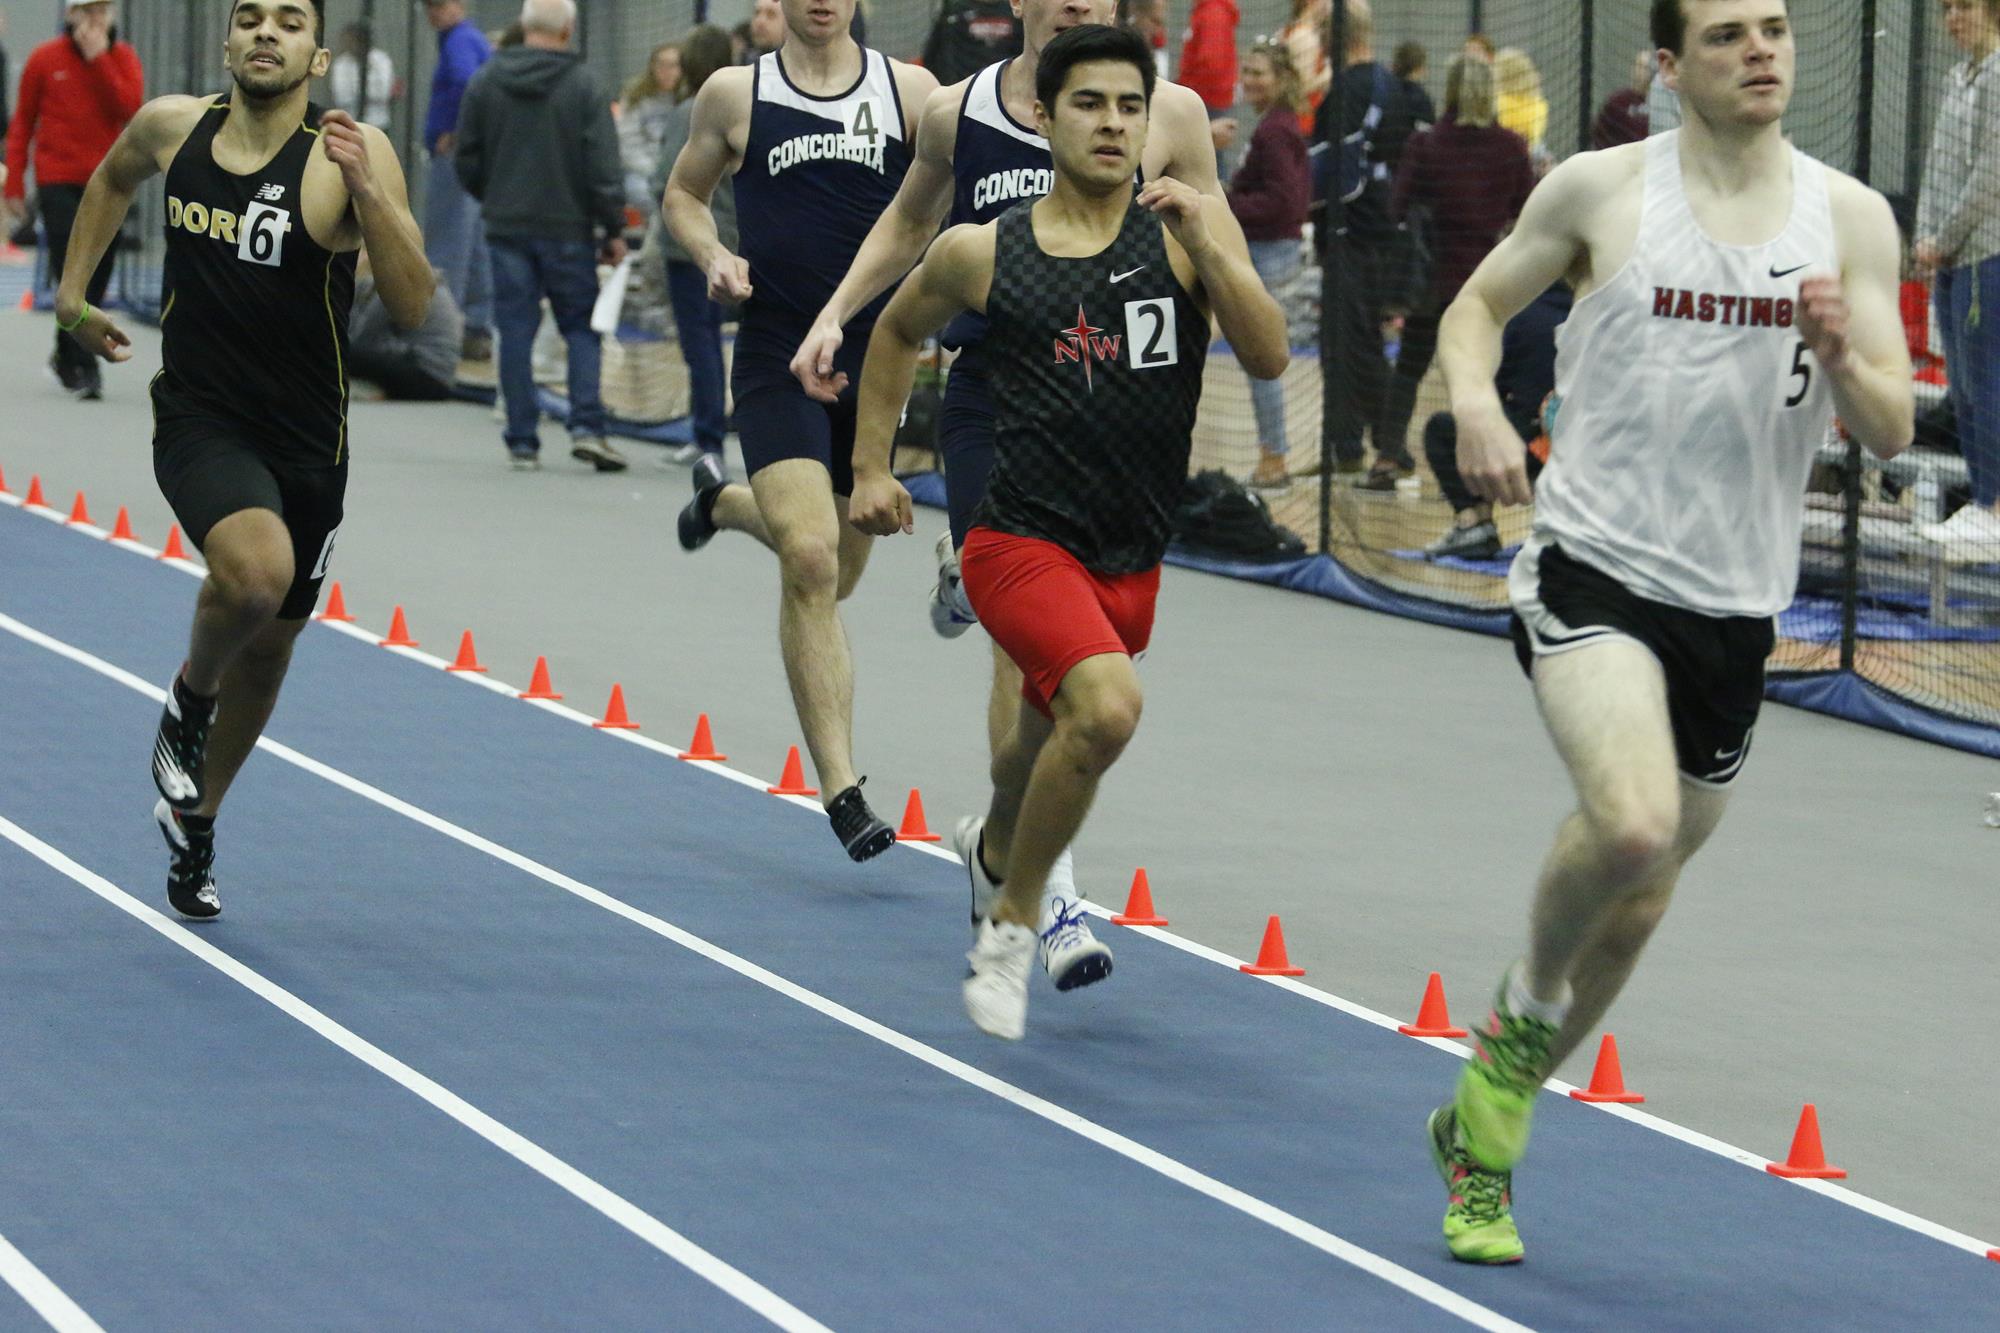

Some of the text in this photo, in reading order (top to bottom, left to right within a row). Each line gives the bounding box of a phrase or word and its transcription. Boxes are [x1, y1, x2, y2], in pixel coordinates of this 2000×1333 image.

[853, 101, 879, 144] 4
[768, 133, 885, 176] CONCORDIA
[168, 195, 292, 246] DOR
[249, 209, 279, 262] 6
[1137, 303, 1169, 364] 2
[1784, 341, 1811, 407] 5
